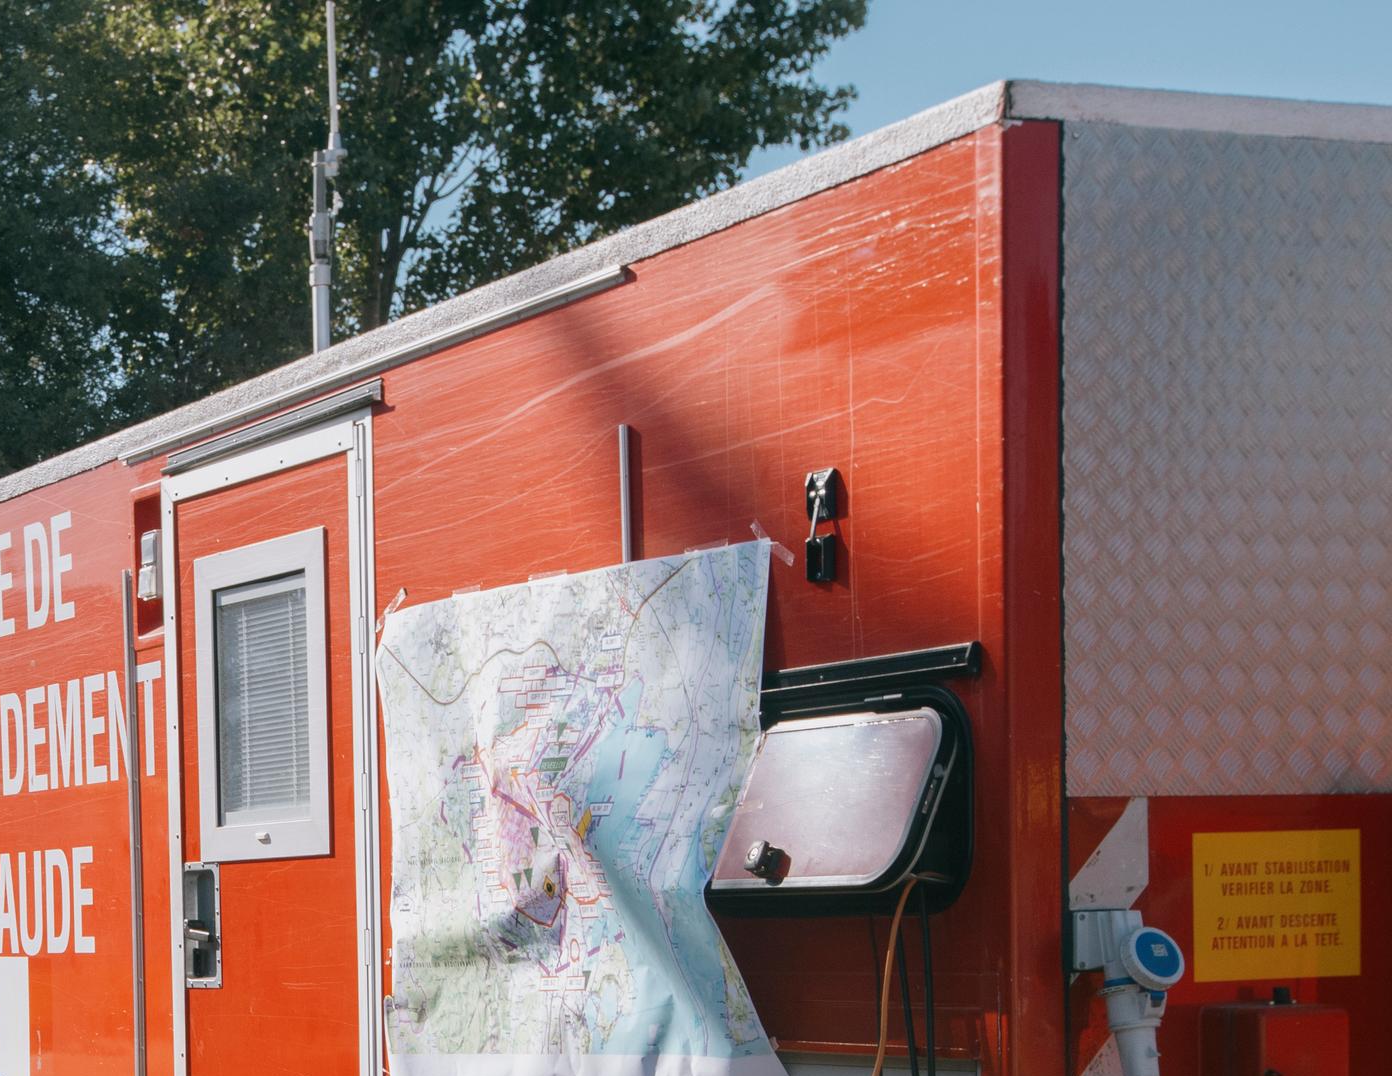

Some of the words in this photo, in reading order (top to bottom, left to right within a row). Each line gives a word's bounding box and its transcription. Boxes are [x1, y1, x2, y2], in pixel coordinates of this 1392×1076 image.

[24, 511, 75, 630] DE
[1220, 862, 1258, 877] AVANT
[1264, 859, 1350, 876] STABILISATION
[1221, 880, 1274, 896] VERIFIER
[1280, 881, 1294, 895] LA
[1236, 915, 1274, 930] AVANT
[1280, 913, 1337, 928] DESCENTE
[1211, 934, 1275, 951] ATTENTION
[1280, 934, 1288, 948] A
[1294, 934, 1308, 948] LA
